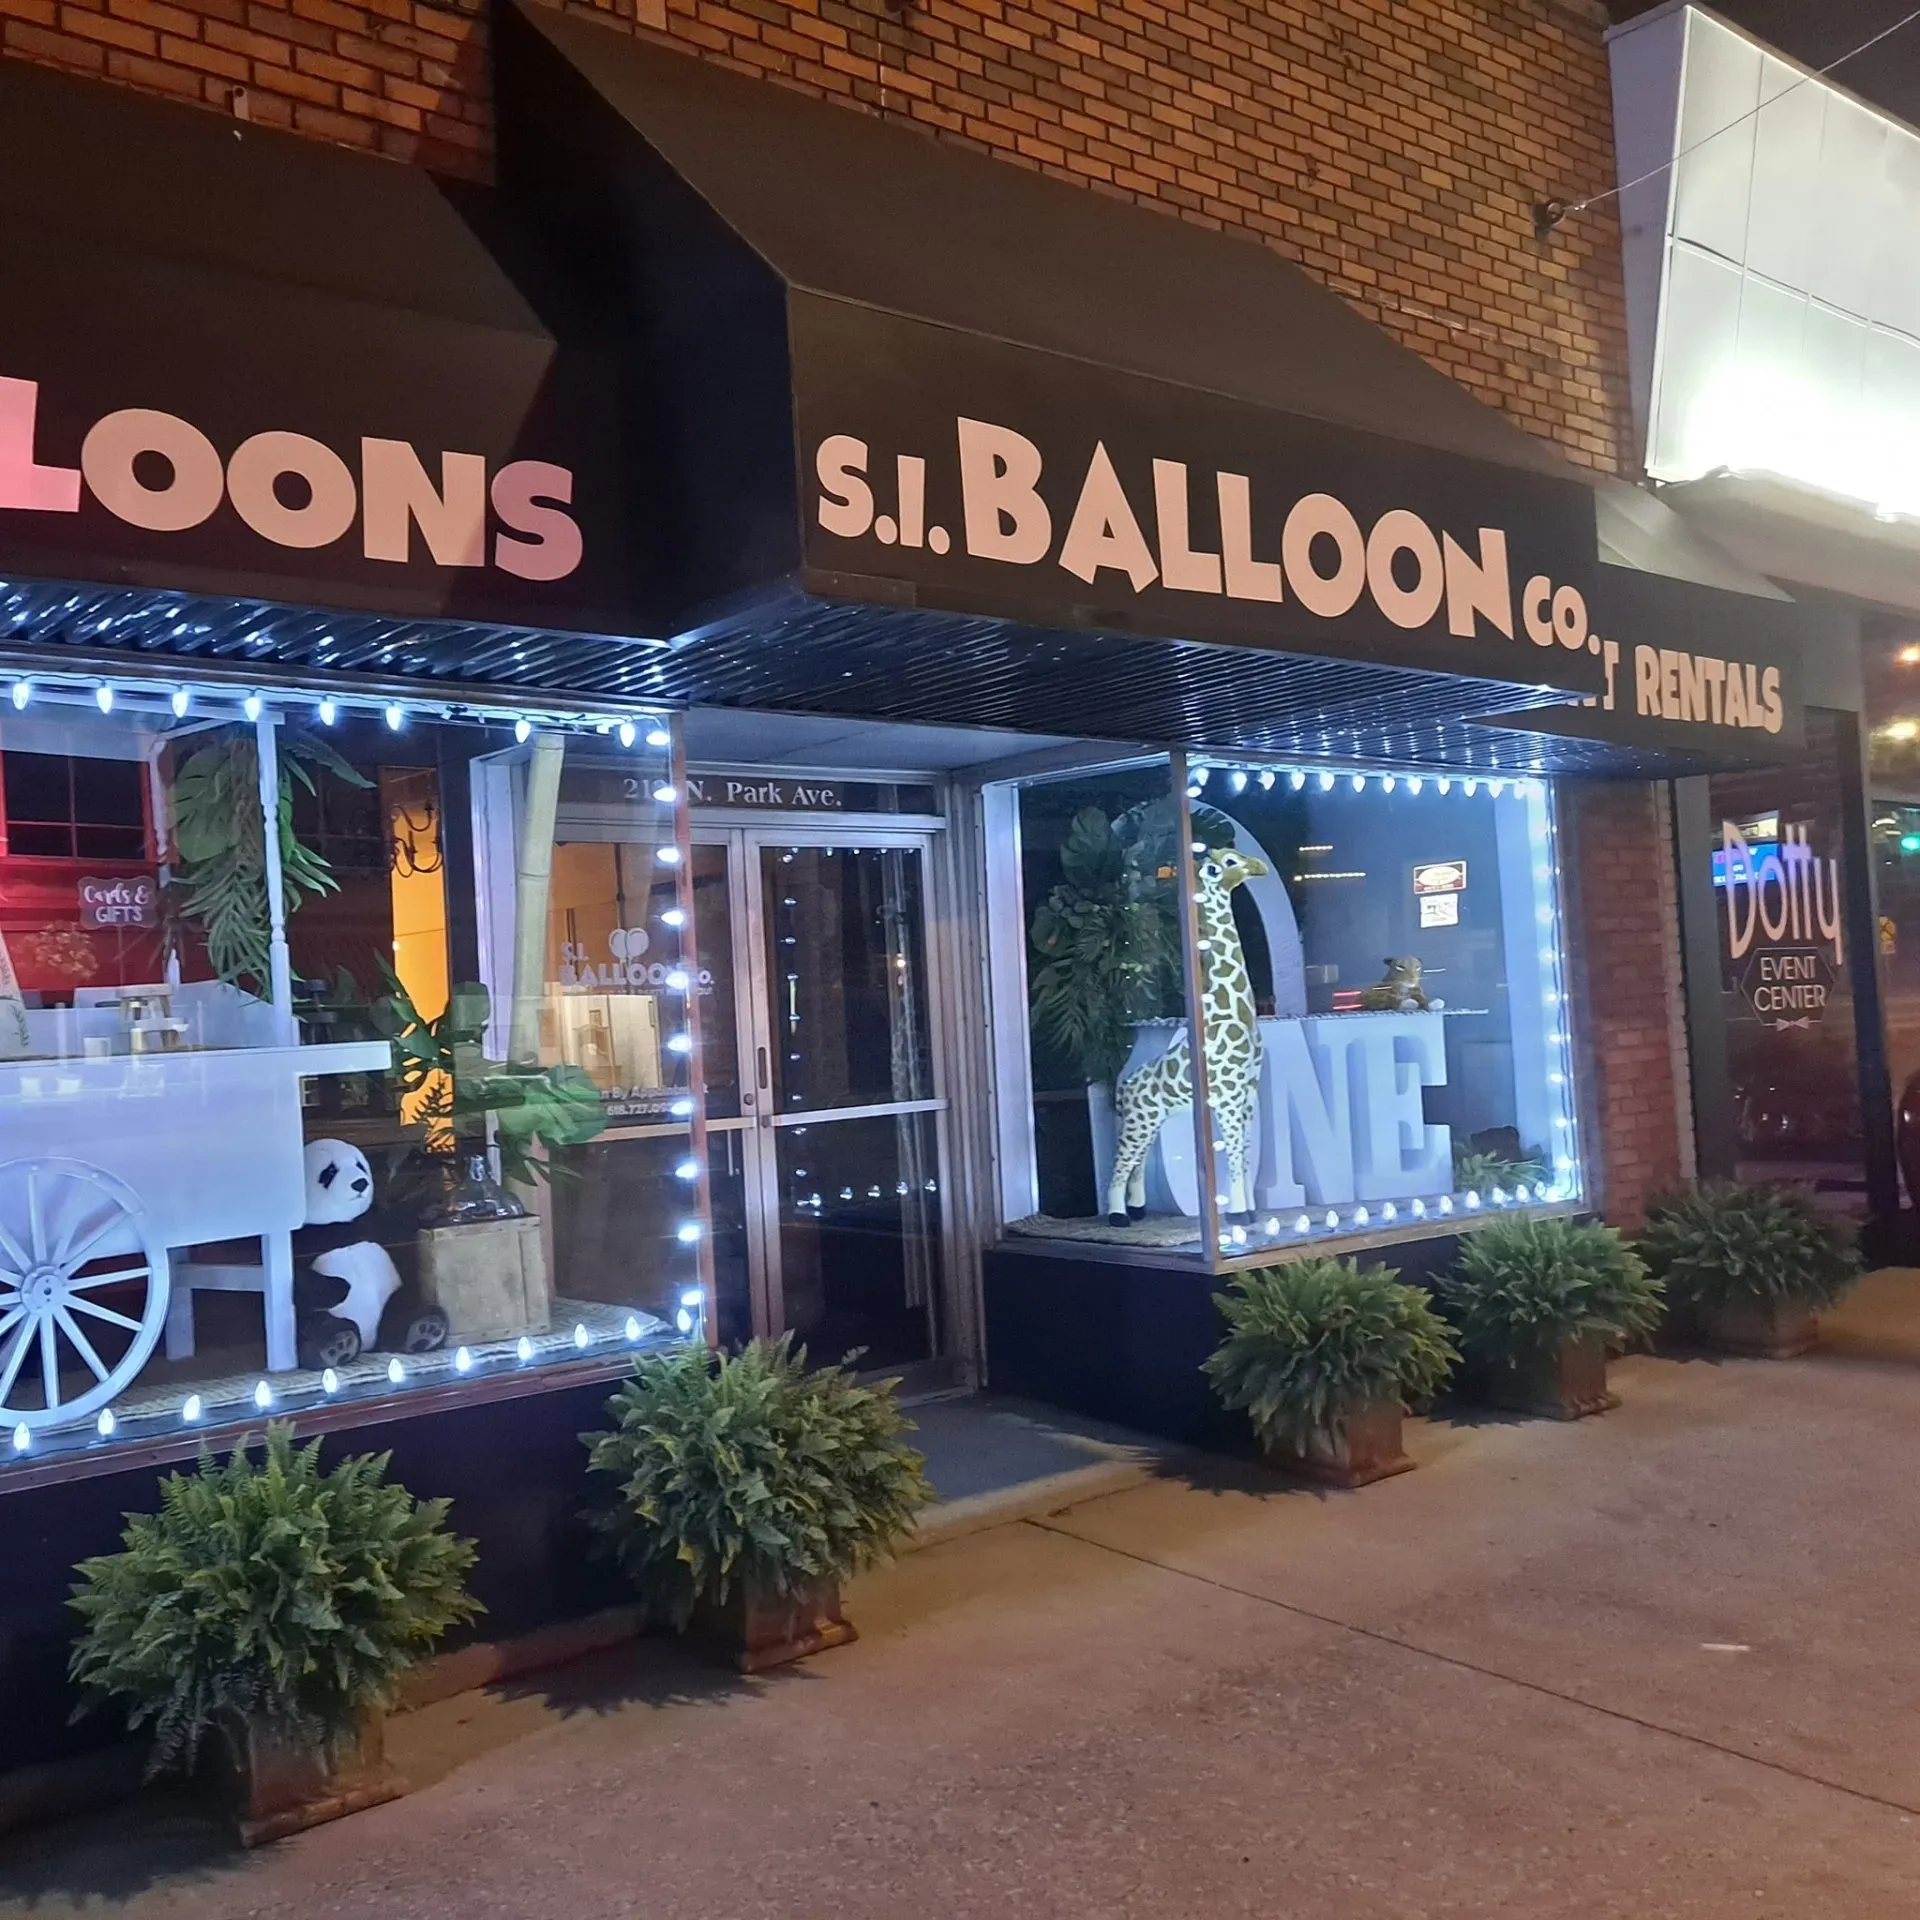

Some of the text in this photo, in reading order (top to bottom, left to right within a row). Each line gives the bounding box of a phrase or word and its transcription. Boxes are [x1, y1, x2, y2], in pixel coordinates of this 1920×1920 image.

[816, 416, 1600, 656] S.I. BALLOON CO.
[1635, 644, 1783, 734] RENTALS
[686, 780, 712, 802] N.
[727, 781, 783, 804] Park
[791, 786, 843, 807] Ave.
[84, 882, 149, 905] Cards &
[1722, 820, 1842, 965] Dotty
[95, 905, 143, 923] GIFTS
[559, 963, 687, 987] BALLOO
[1760, 955, 1817, 981] EVENT
[1754, 984, 1826, 1012] CENTER
